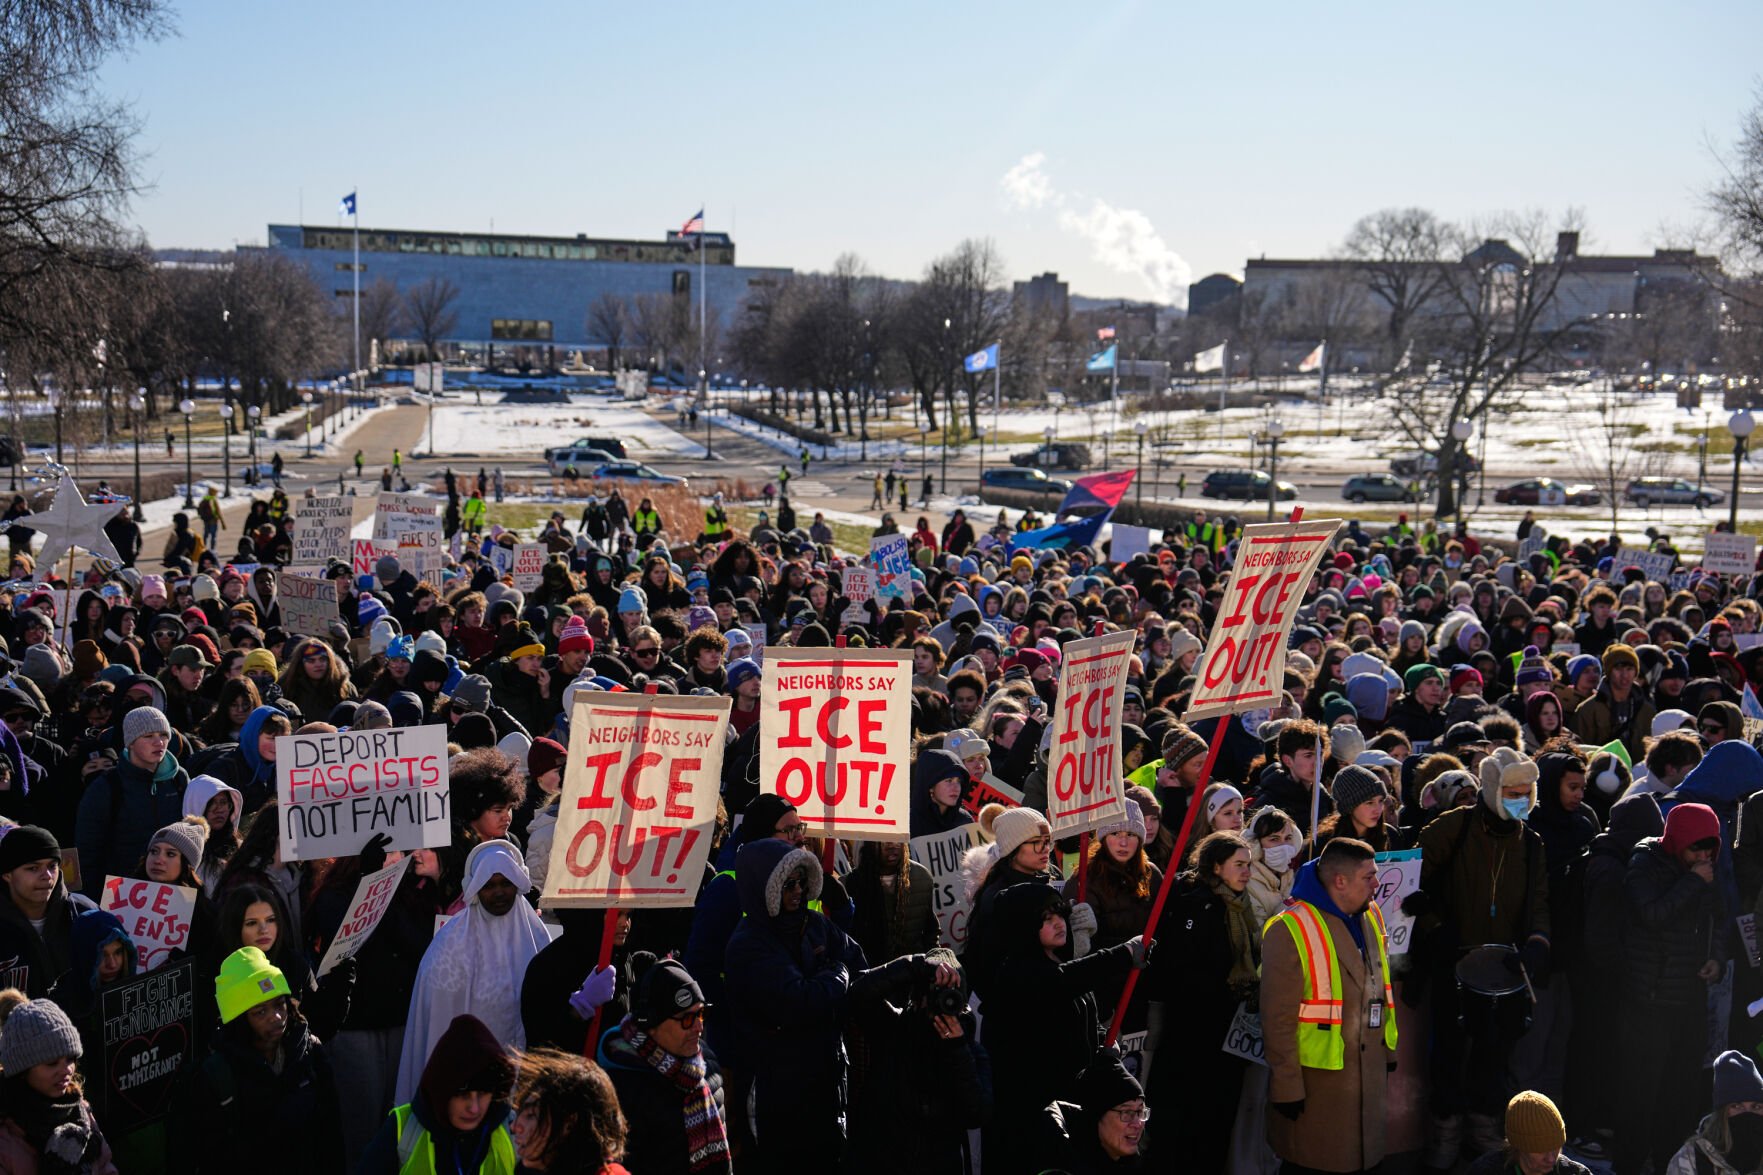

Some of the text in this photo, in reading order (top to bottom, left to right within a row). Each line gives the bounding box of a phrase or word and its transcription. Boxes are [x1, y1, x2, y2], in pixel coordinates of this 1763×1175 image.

[427, 532, 437, 547] IS
[848, 574, 868, 583] ICE
[1243, 551, 1296, 569] NEIGHBORS
[281, 576, 335, 602] STOP ICE
[846, 584, 868, 592] OUT
[1222, 572, 1300, 628] ICE
[1067, 664, 1121, 688] NEIGHBORS SAY
[1204, 632, 1281, 689] OUT!
[778, 675, 895, 691] NEIGHBORS SAY
[778, 696, 887, 754] ICE
[1060, 686, 1114, 744] ICE
[295, 731, 404, 768] DEPORT
[589, 726, 713, 747] NEIGHBORS SAY
[290, 756, 439, 802] FASCISTS
[577, 750, 701, 819] ICE
[776, 757, 896, 815] OUT!
[1055, 743, 1114, 802] OUT!
[287, 791, 449, 839] NOT FAMILY
[566, 820, 700, 884] OUT!
[106, 878, 173, 915] ICE
[354, 889, 393, 919] OUT
[365, 873, 395, 900] ICE
[122, 970, 181, 1013] FIGHT
[105, 992, 192, 1045] IGNORANCE
[119, 1052, 182, 1090] IMMIGRANTS
[131, 1046, 159, 1069] NOT
